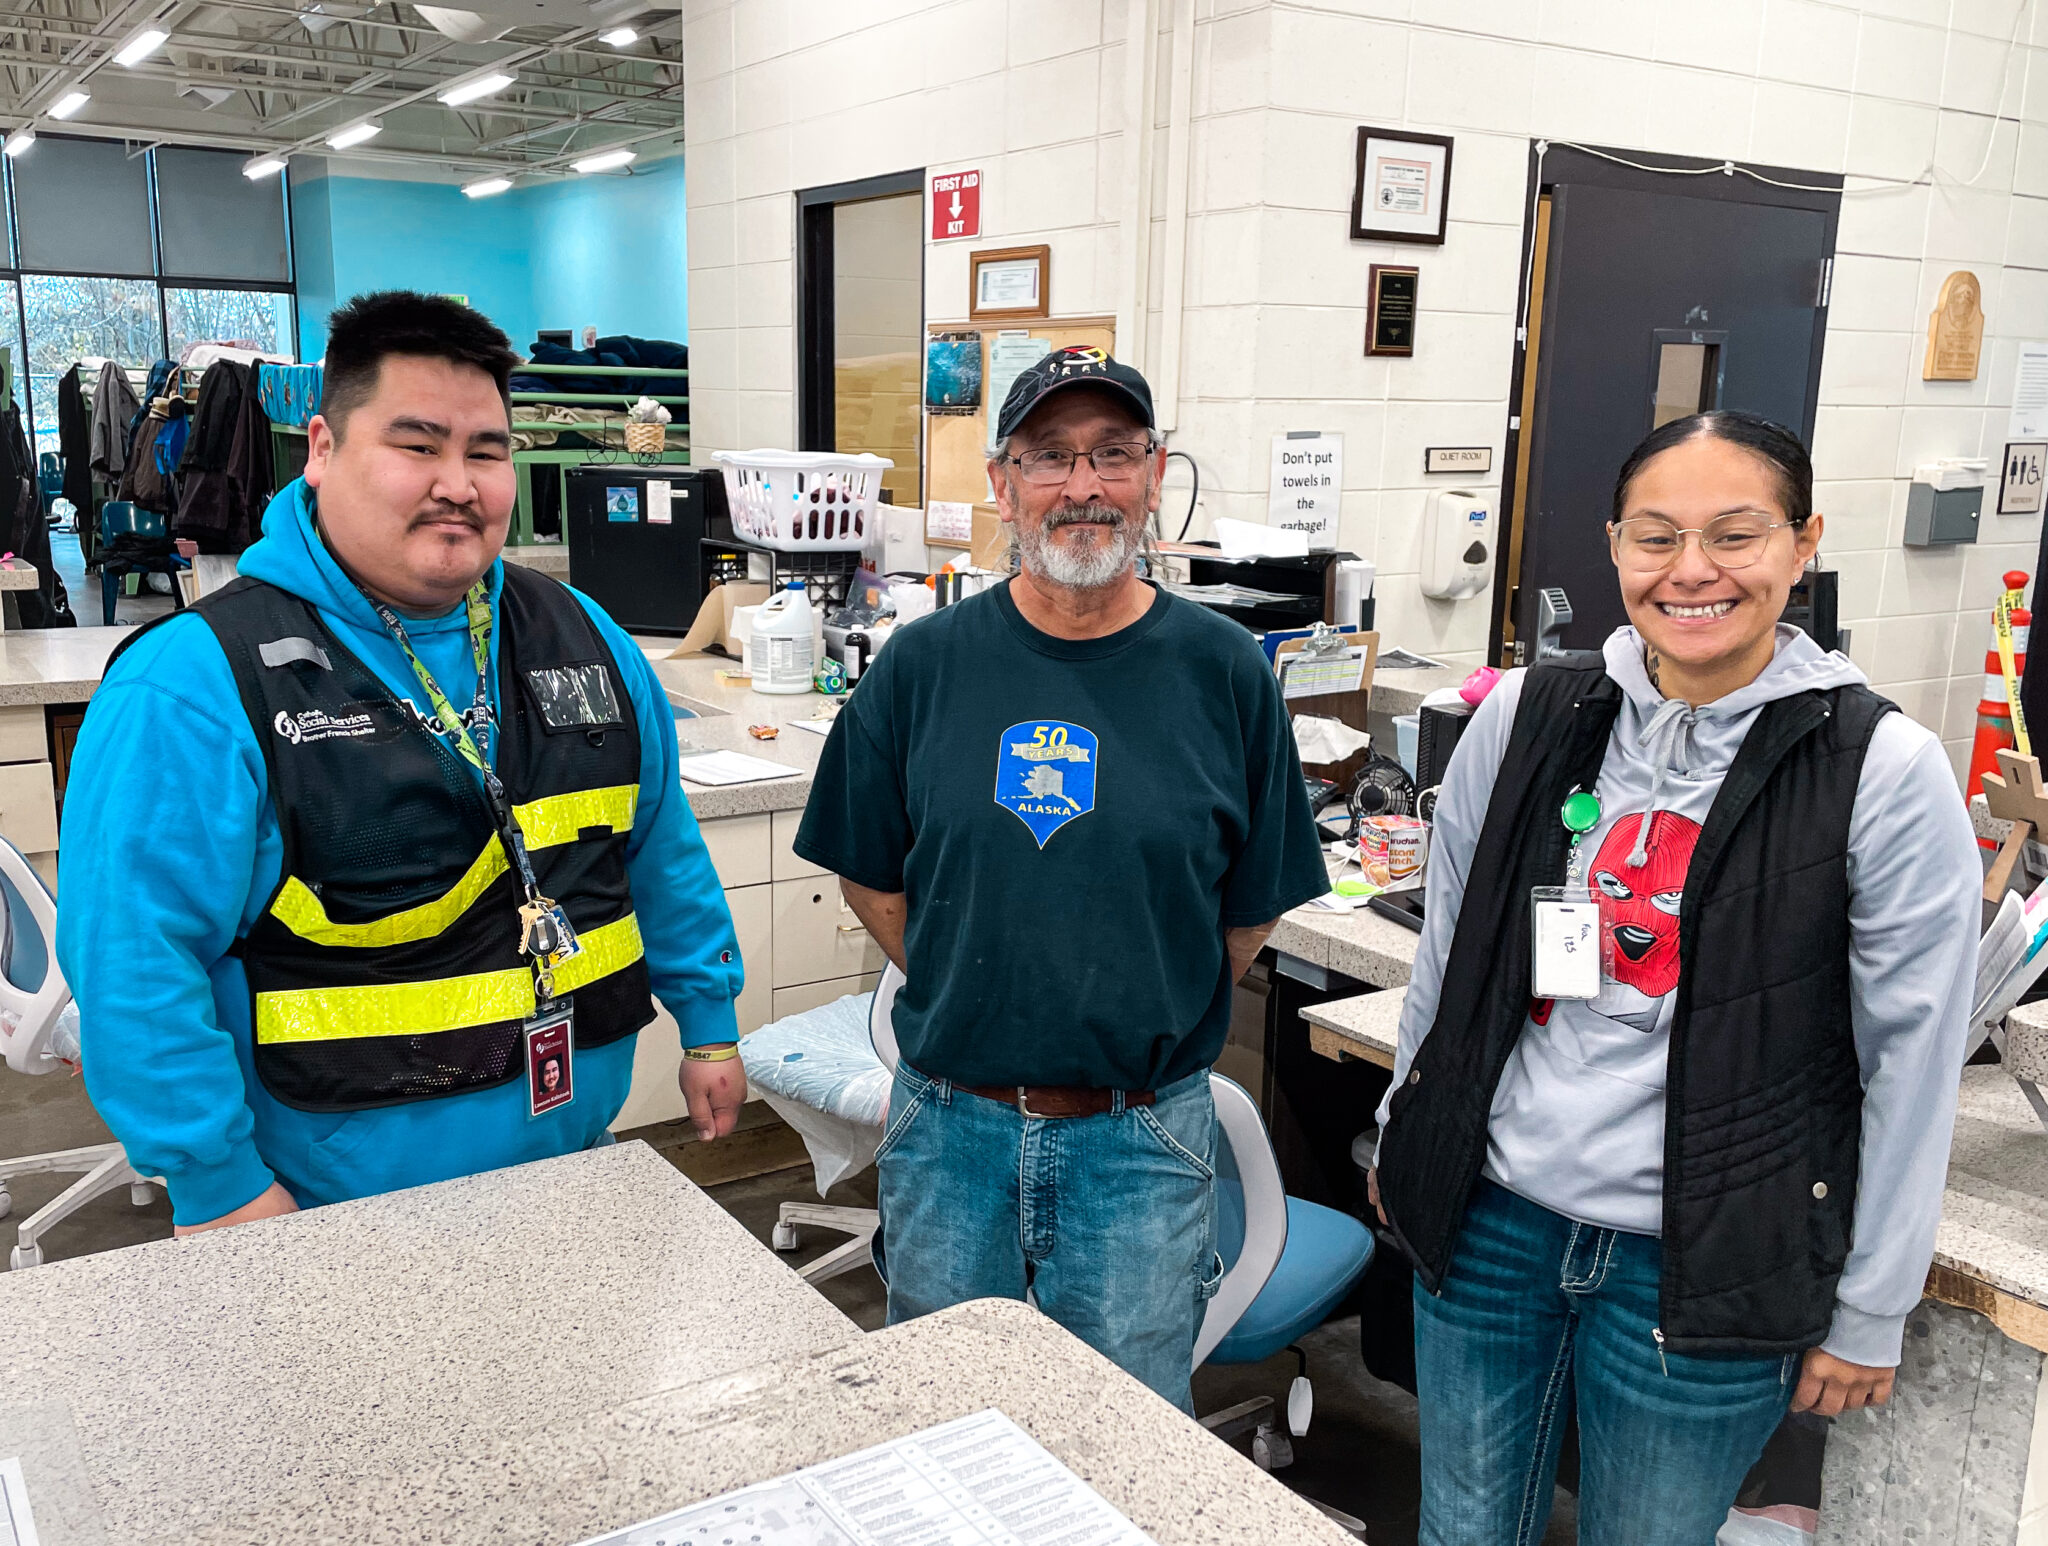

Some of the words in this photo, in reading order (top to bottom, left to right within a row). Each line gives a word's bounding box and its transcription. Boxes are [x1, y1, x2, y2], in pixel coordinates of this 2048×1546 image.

[934, 176, 961, 192] FIRST
[962, 173, 979, 189] AID
[947, 220, 965, 234] KIT
[1282, 451, 1312, 465] Don't
[1315, 452, 1333, 467] put
[1440, 452, 1460, 461] QUIET
[1461, 452, 1482, 461] ROOM
[1283, 473, 1319, 488] towels
[1321, 473, 1331, 486] in
[1297, 497, 1315, 510] the
[298, 715, 330, 729] Social
[329, 714, 371, 726] Services
[1030, 726, 1068, 749] 50
[1028, 747, 1073, 759] YEARS
[1017, 802, 1072, 816] ALASKA
